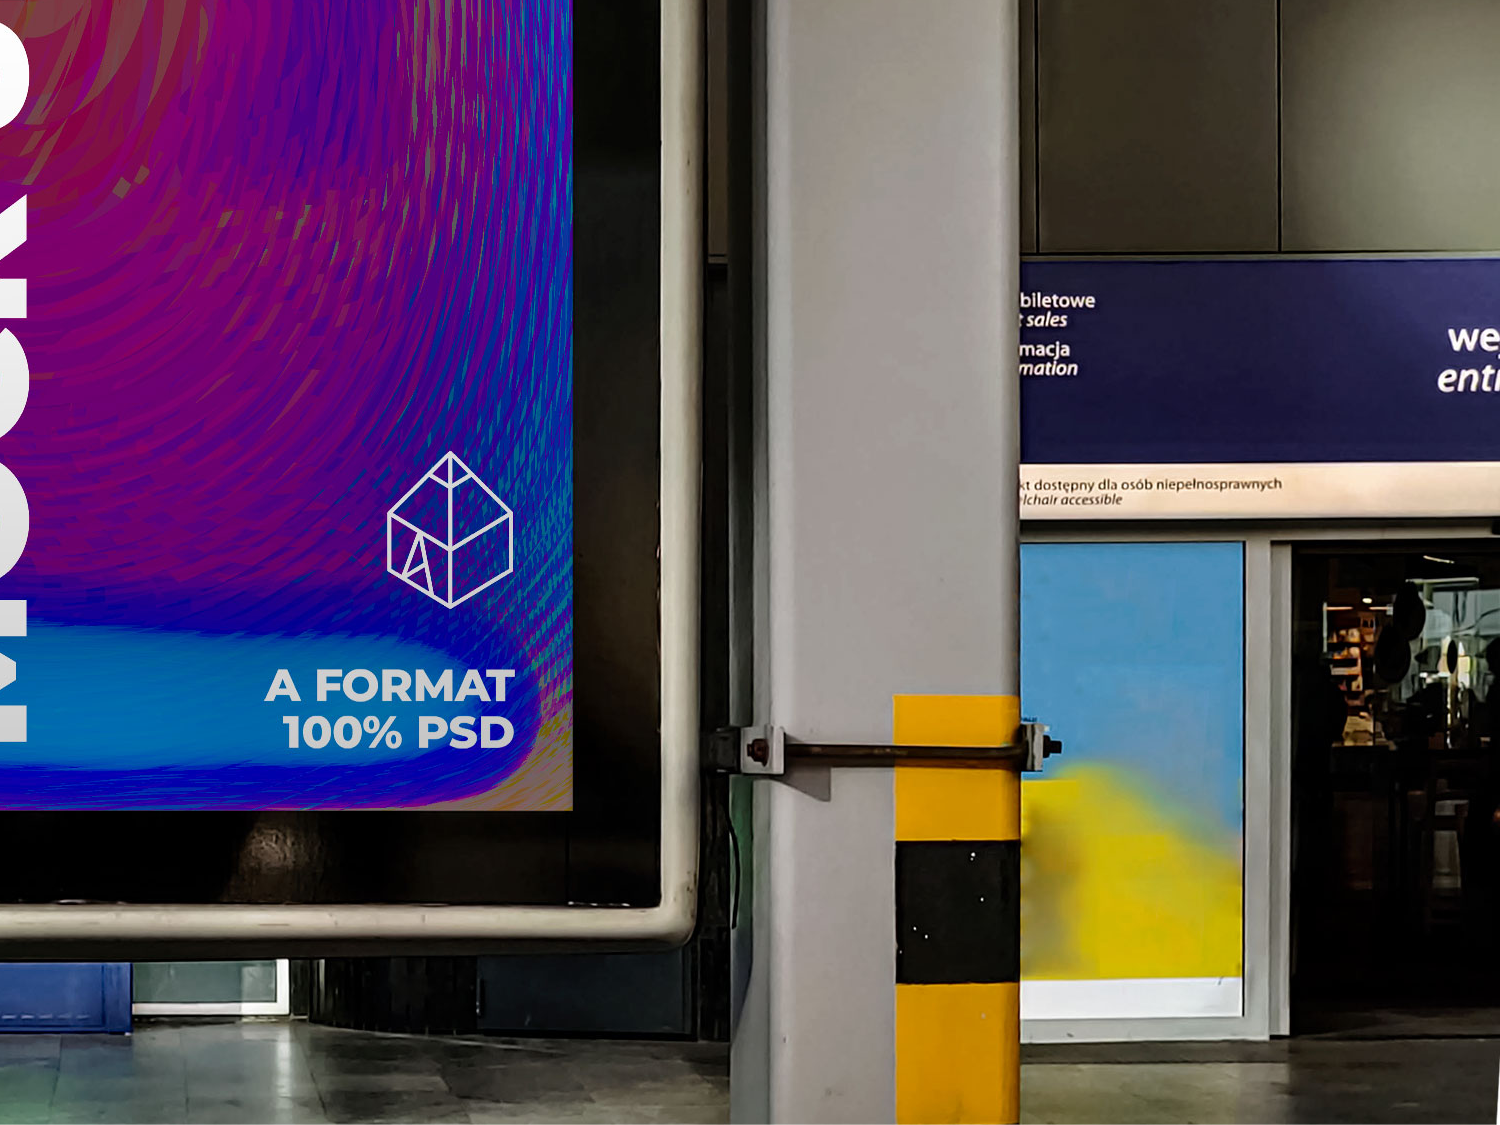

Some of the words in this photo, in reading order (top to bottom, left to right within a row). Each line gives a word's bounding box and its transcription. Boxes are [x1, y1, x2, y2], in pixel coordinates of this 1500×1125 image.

[1020, 292, 1096, 308] biletowe
[1026, 311, 1068, 327] sales
[1019, 341, 1071, 360] macja
[1448, 328, 1500, 360] we
[1019, 361, 1079, 376] mation
[1098, 478, 1118, 490] dla
[1121, 478, 1153, 490] osób
[1021, 494, 1058, 505] lchair
[1060, 493, 1123, 505] accessible
[264, 668, 301, 702] A
[316, 668, 516, 702] FORMAT
[282, 715, 402, 749] 100%
[418, 715, 515, 749] PSD
